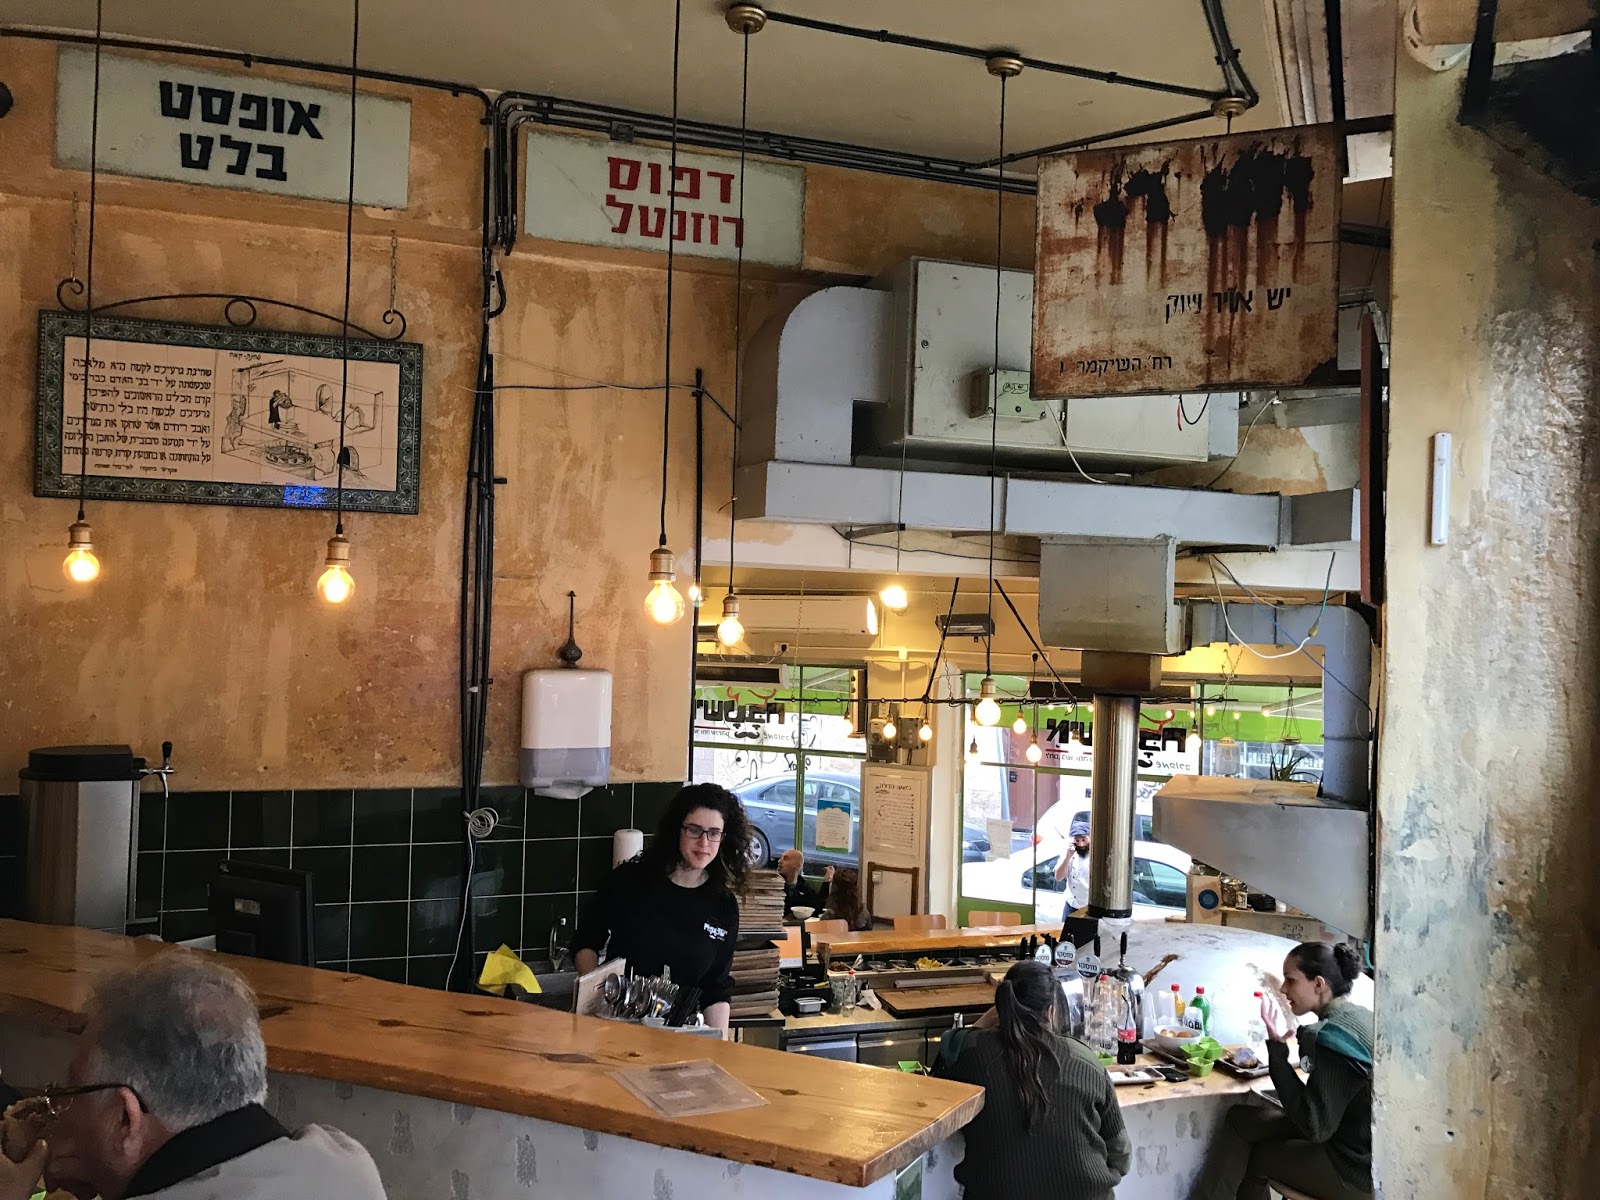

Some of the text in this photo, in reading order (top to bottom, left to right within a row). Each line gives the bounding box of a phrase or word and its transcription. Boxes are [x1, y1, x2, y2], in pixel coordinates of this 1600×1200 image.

[159, 80, 324, 140] אופסט
[179, 132, 287, 182] בלט
[607, 156, 735, 204] דפוס
[605, 194, 744, 248] רוזנטל
[1266, 286, 1292, 311] יש
[165, 376, 176, 388] על
